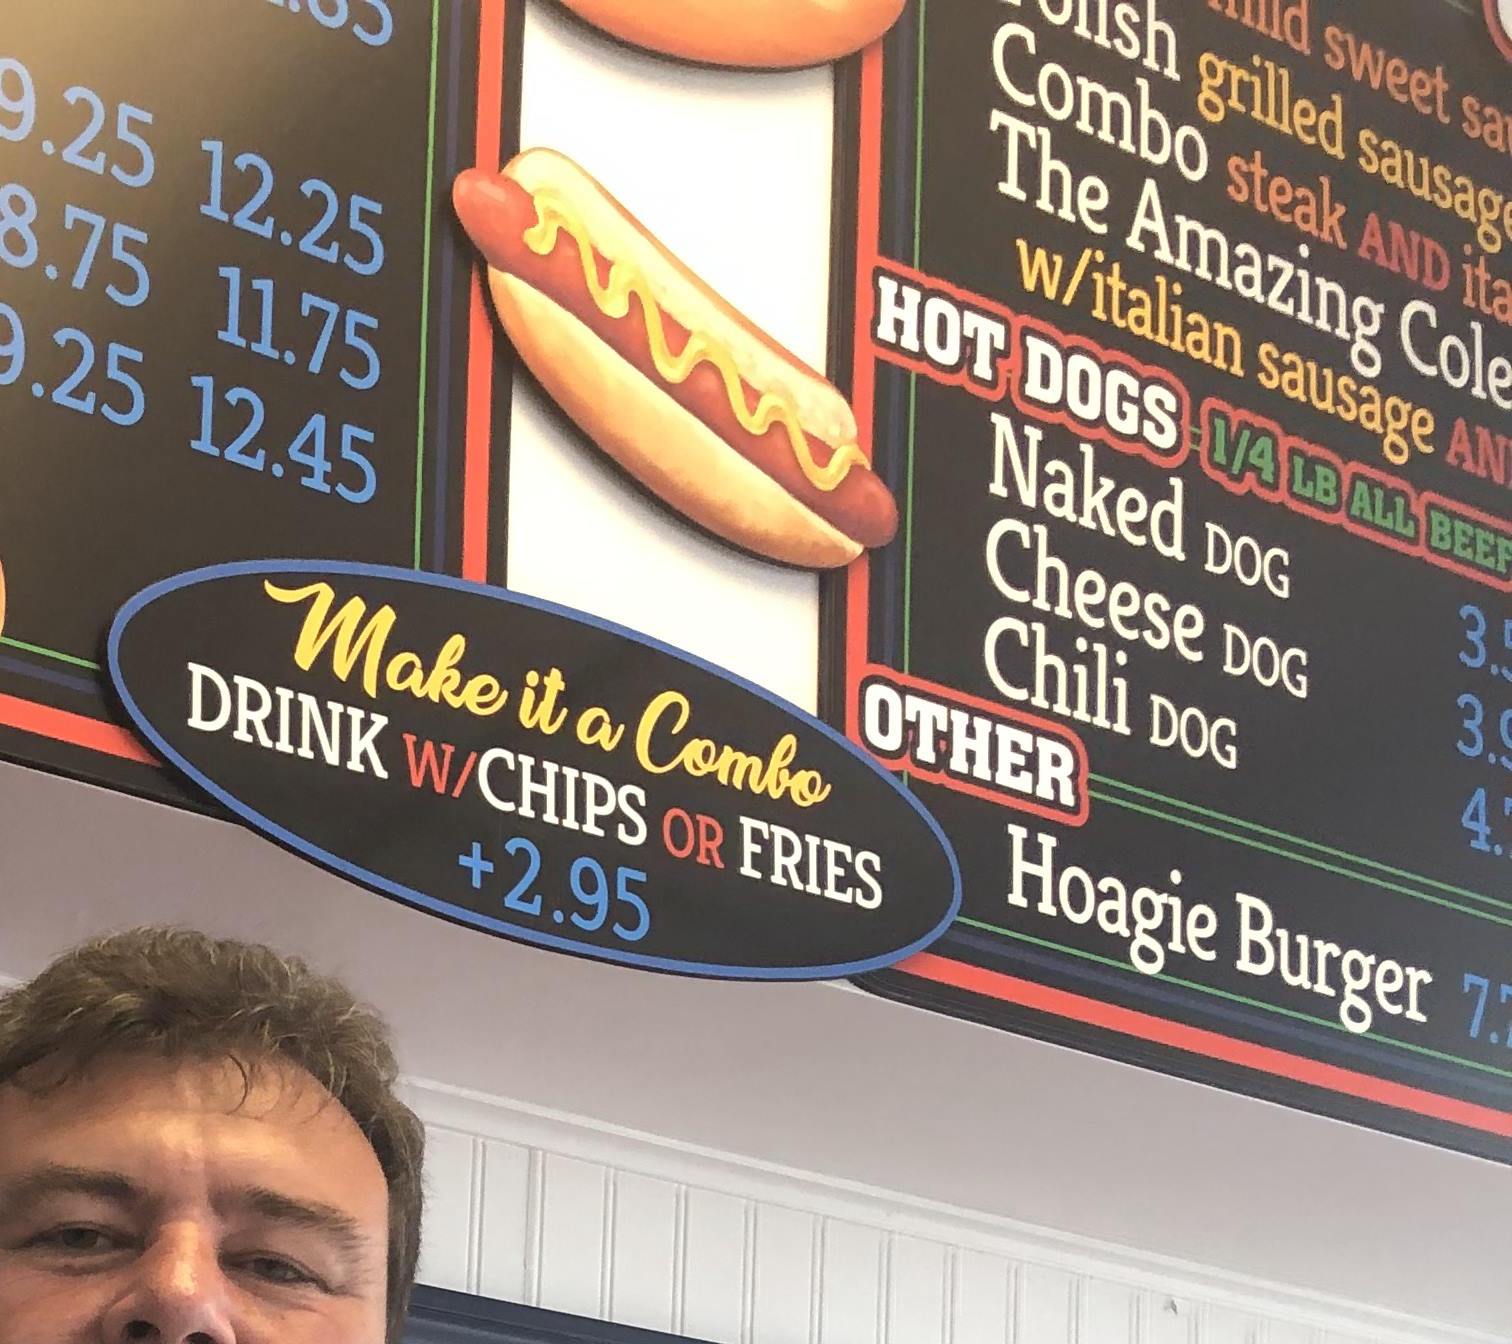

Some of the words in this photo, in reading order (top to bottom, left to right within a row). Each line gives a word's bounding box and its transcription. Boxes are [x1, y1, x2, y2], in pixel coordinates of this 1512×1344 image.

[991, 22, 1208, 180] Combo
[1196, 52, 1346, 161] grilled
[1323, 25, 1450, 124] sweet
[199, 139, 385, 276] 12.25
[990, 109, 1110, 235] The
[1124, 177, 1385, 379] Amazing
[1226, 150, 1348, 250] steak
[1357, 211, 1451, 291] AND
[216, 266, 382, 390] 11.75
[875, 276, 1006, 383] HOT
[1023, 335, 1178, 450] DOGS
[1213, 417, 1275, 484] 1/4
[1292, 455, 1337, 506] LB
[1350, 480, 1416, 538] ALL
[1015, 237, 1245, 378] w/italian
[1257, 341, 1436, 465] sausage
[1445, 416, 1512, 489] AN
[190, 375, 377, 504] 12.45
[988, 411, 1187, 562] Naked
[1204, 521, 1291, 599] DOG
[985, 517, 1206, 663] Cheese
[1223, 623, 1309, 699] DOG
[263, 578, 509, 719] Make
[518, 666, 571, 737] it
[575, 706, 625, 753] a
[635, 689, 832, 810] Combo
[864, 683, 1077, 808] OTHER
[984, 616, 1132, 736] Chili
[1149, 693, 1238, 770] DOG
[185, 659, 390, 781] DRINK
[662, 809, 726, 872] OR
[739, 815, 884, 910] FRIES
[457, 836, 652, 943] +2.95
[1006, 823, 1218, 975] Hoagie
[1235, 892, 1434, 1034] Burger
